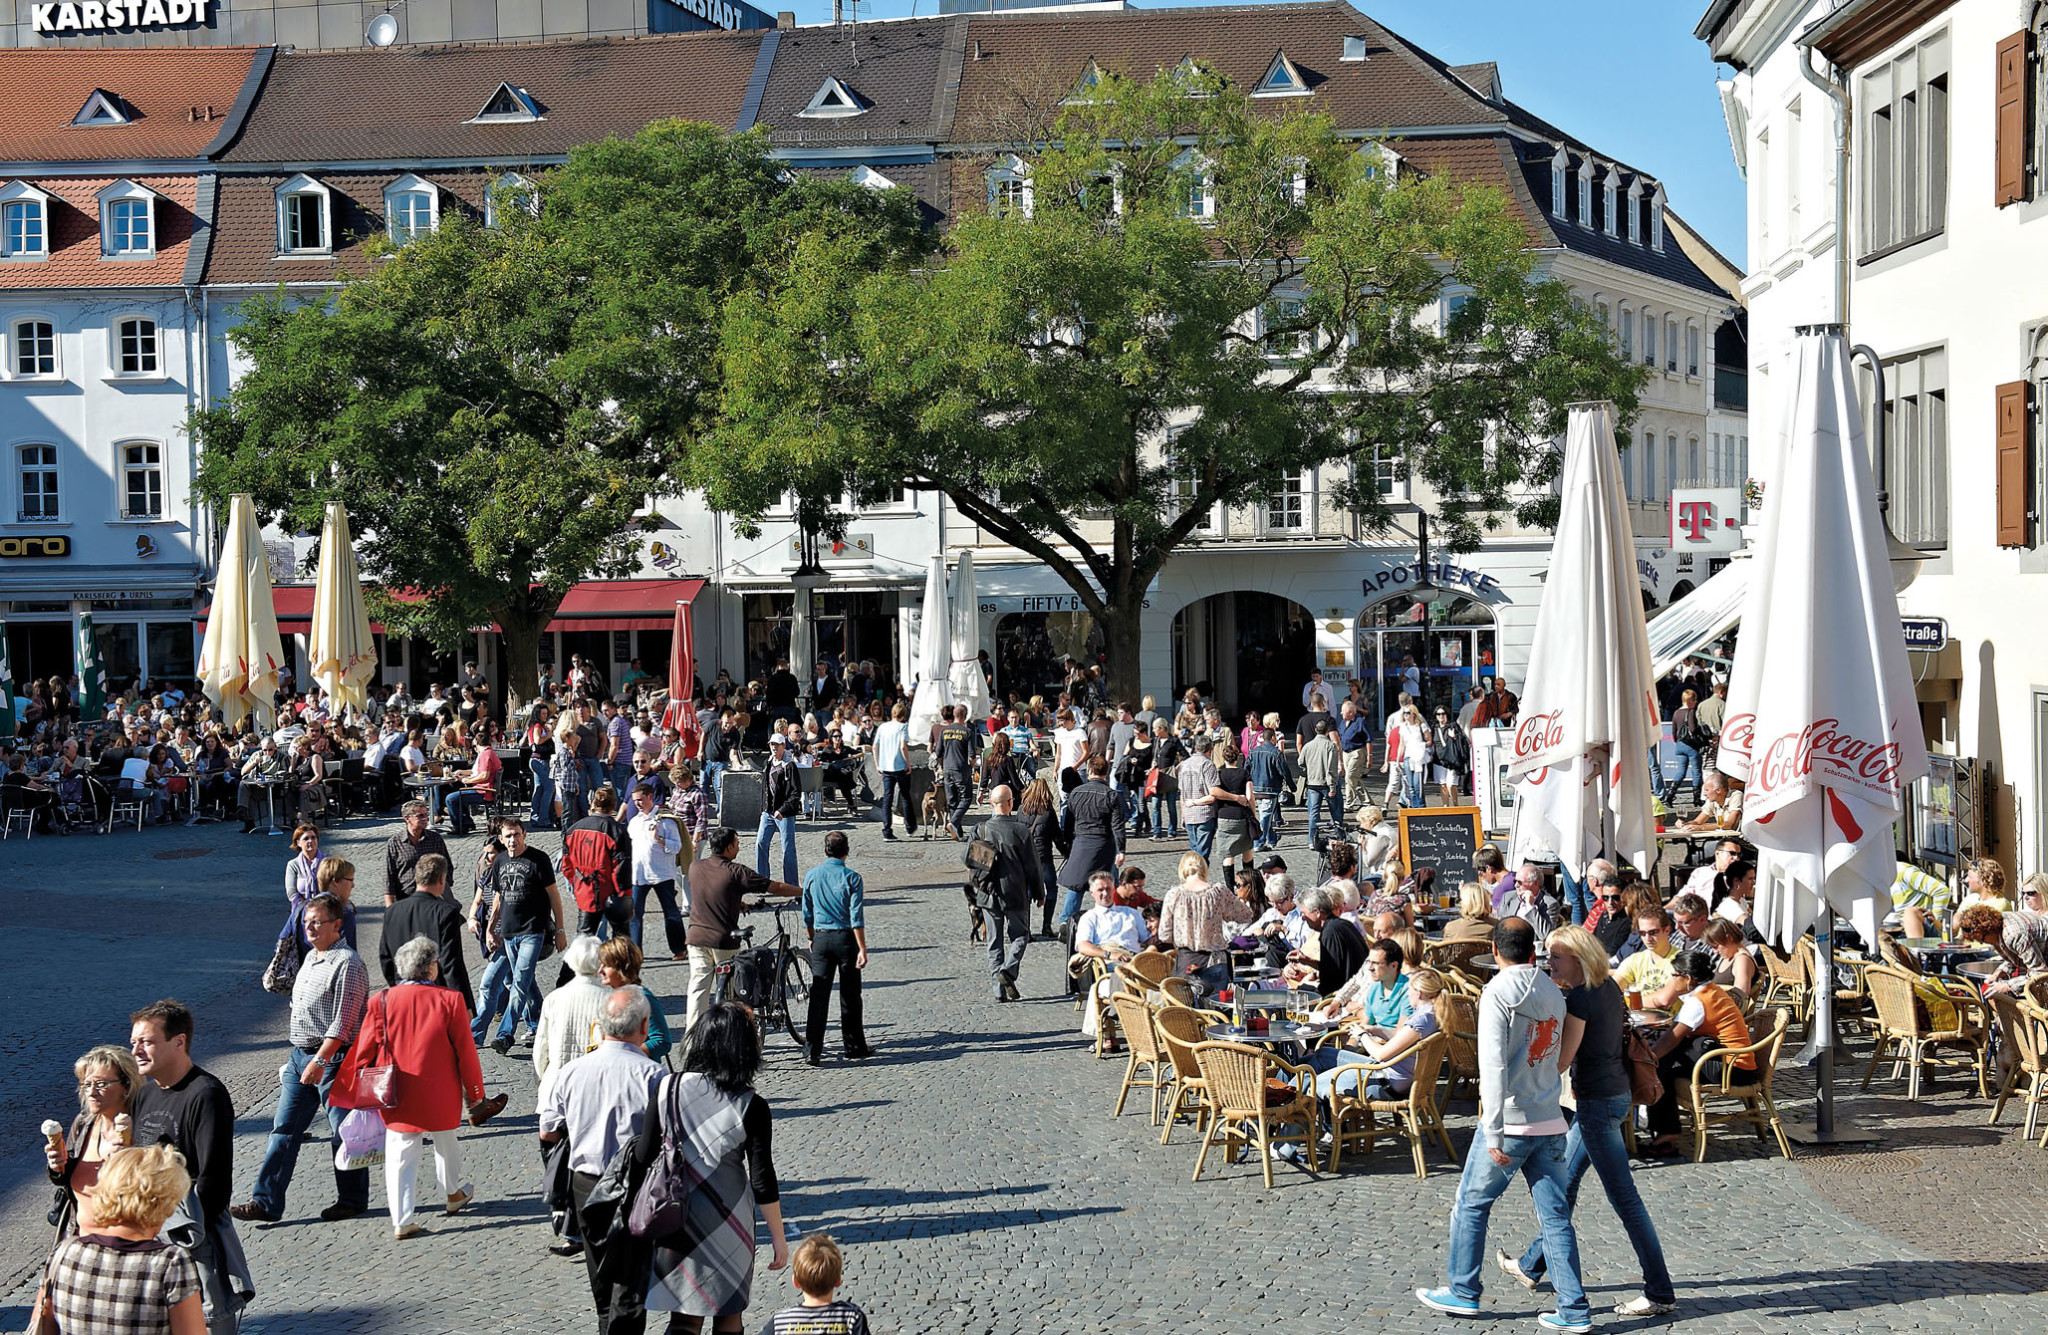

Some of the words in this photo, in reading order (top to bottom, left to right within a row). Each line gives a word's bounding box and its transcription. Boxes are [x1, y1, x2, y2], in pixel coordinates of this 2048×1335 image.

[31, 0, 209, 31] KARSTADT
[73, 592, 116, 600] KARLSBERG
[1361, 562, 1500, 597] APOTHEKE
[1514, 708, 1565, 757] Cola
